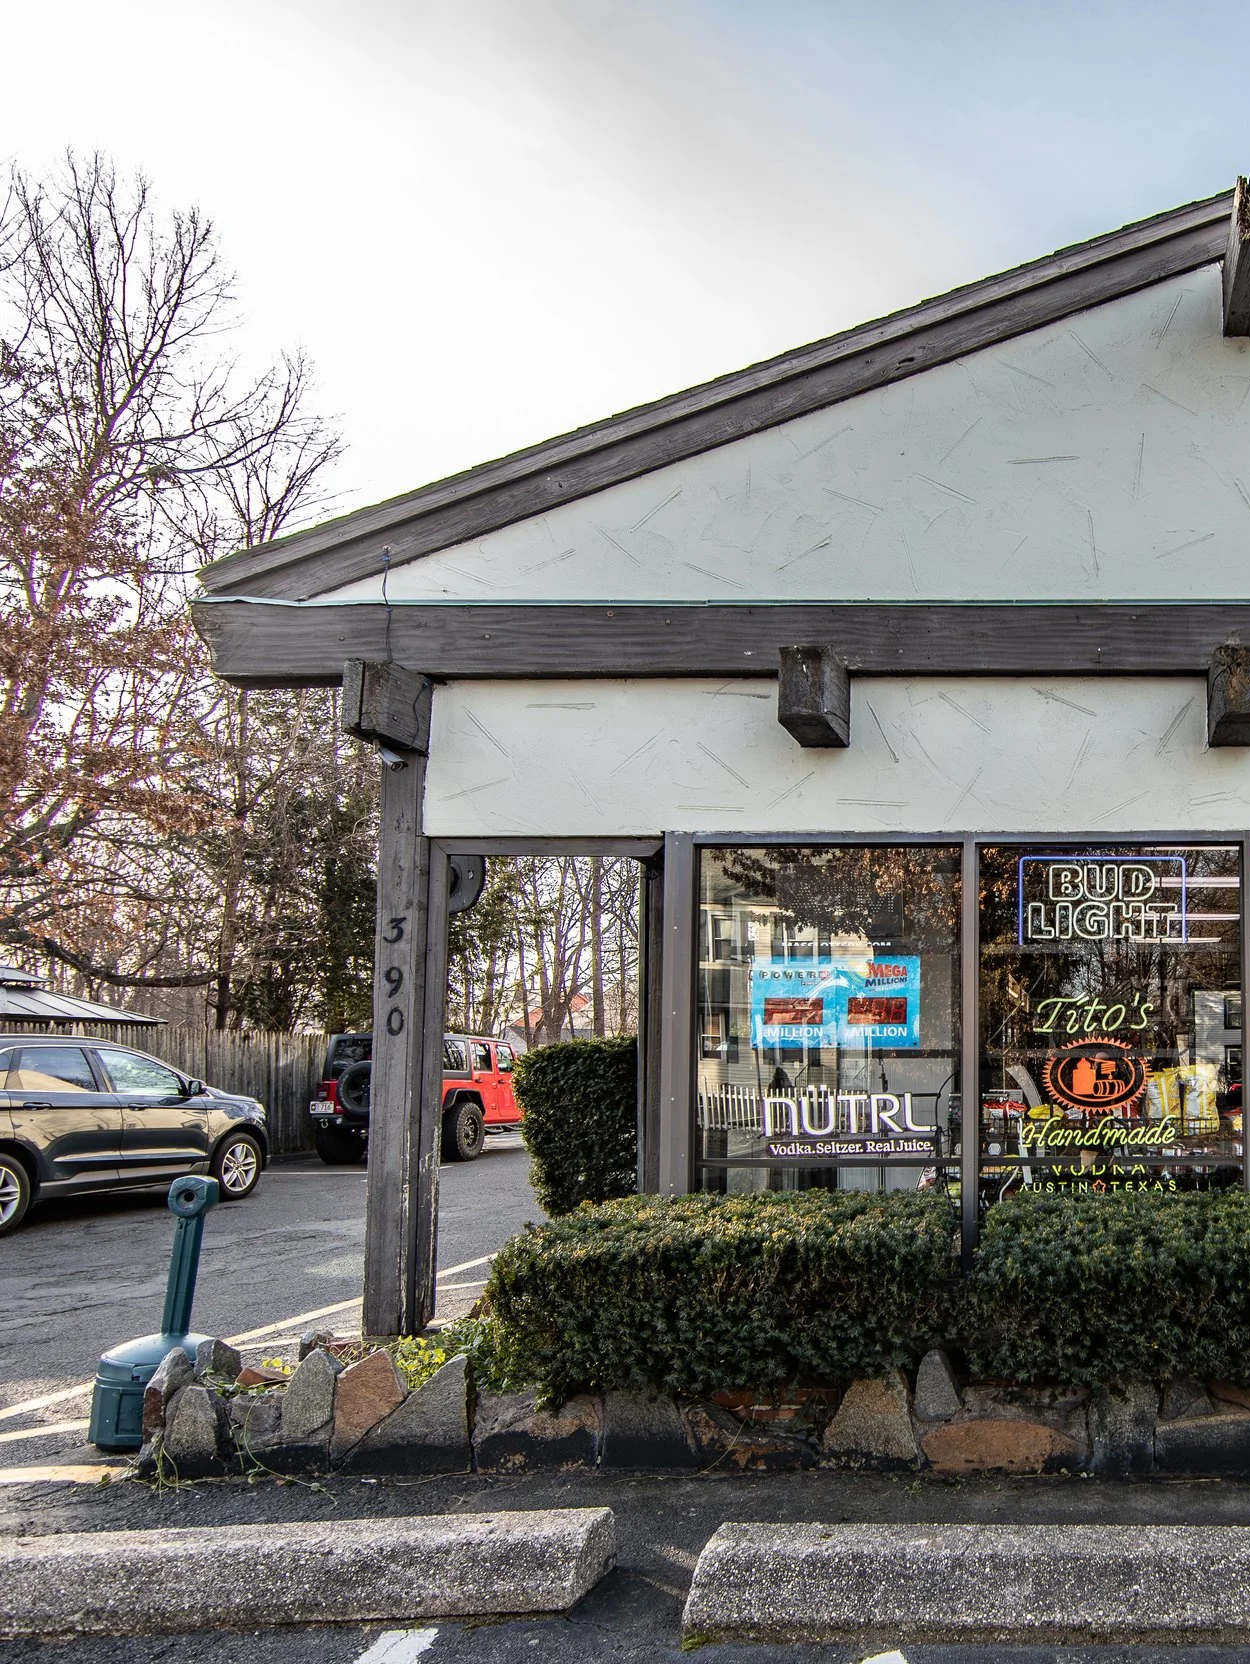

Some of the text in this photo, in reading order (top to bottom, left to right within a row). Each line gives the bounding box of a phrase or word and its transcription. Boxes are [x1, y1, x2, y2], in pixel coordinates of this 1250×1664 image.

[1049, 864, 1156, 901] BUD
[1028, 901, 1178, 939] LIGHT
[382, 916, 407, 1037] 390
[866, 961, 908, 978] MEGA
[865, 976, 908, 987] MILLIONS
[1033, 991, 1154, 1034] Tito's
[767, 1026, 823, 1037] MILLION
[852, 1026, 908, 1037] MILLION
[1020, 1113, 1177, 1149] Handmade
[865, 1140, 895, 1152] Real
[897, 1139, 934, 1152] Juice.
[1019, 1179, 1177, 1194] AUSTIN TEXAS
